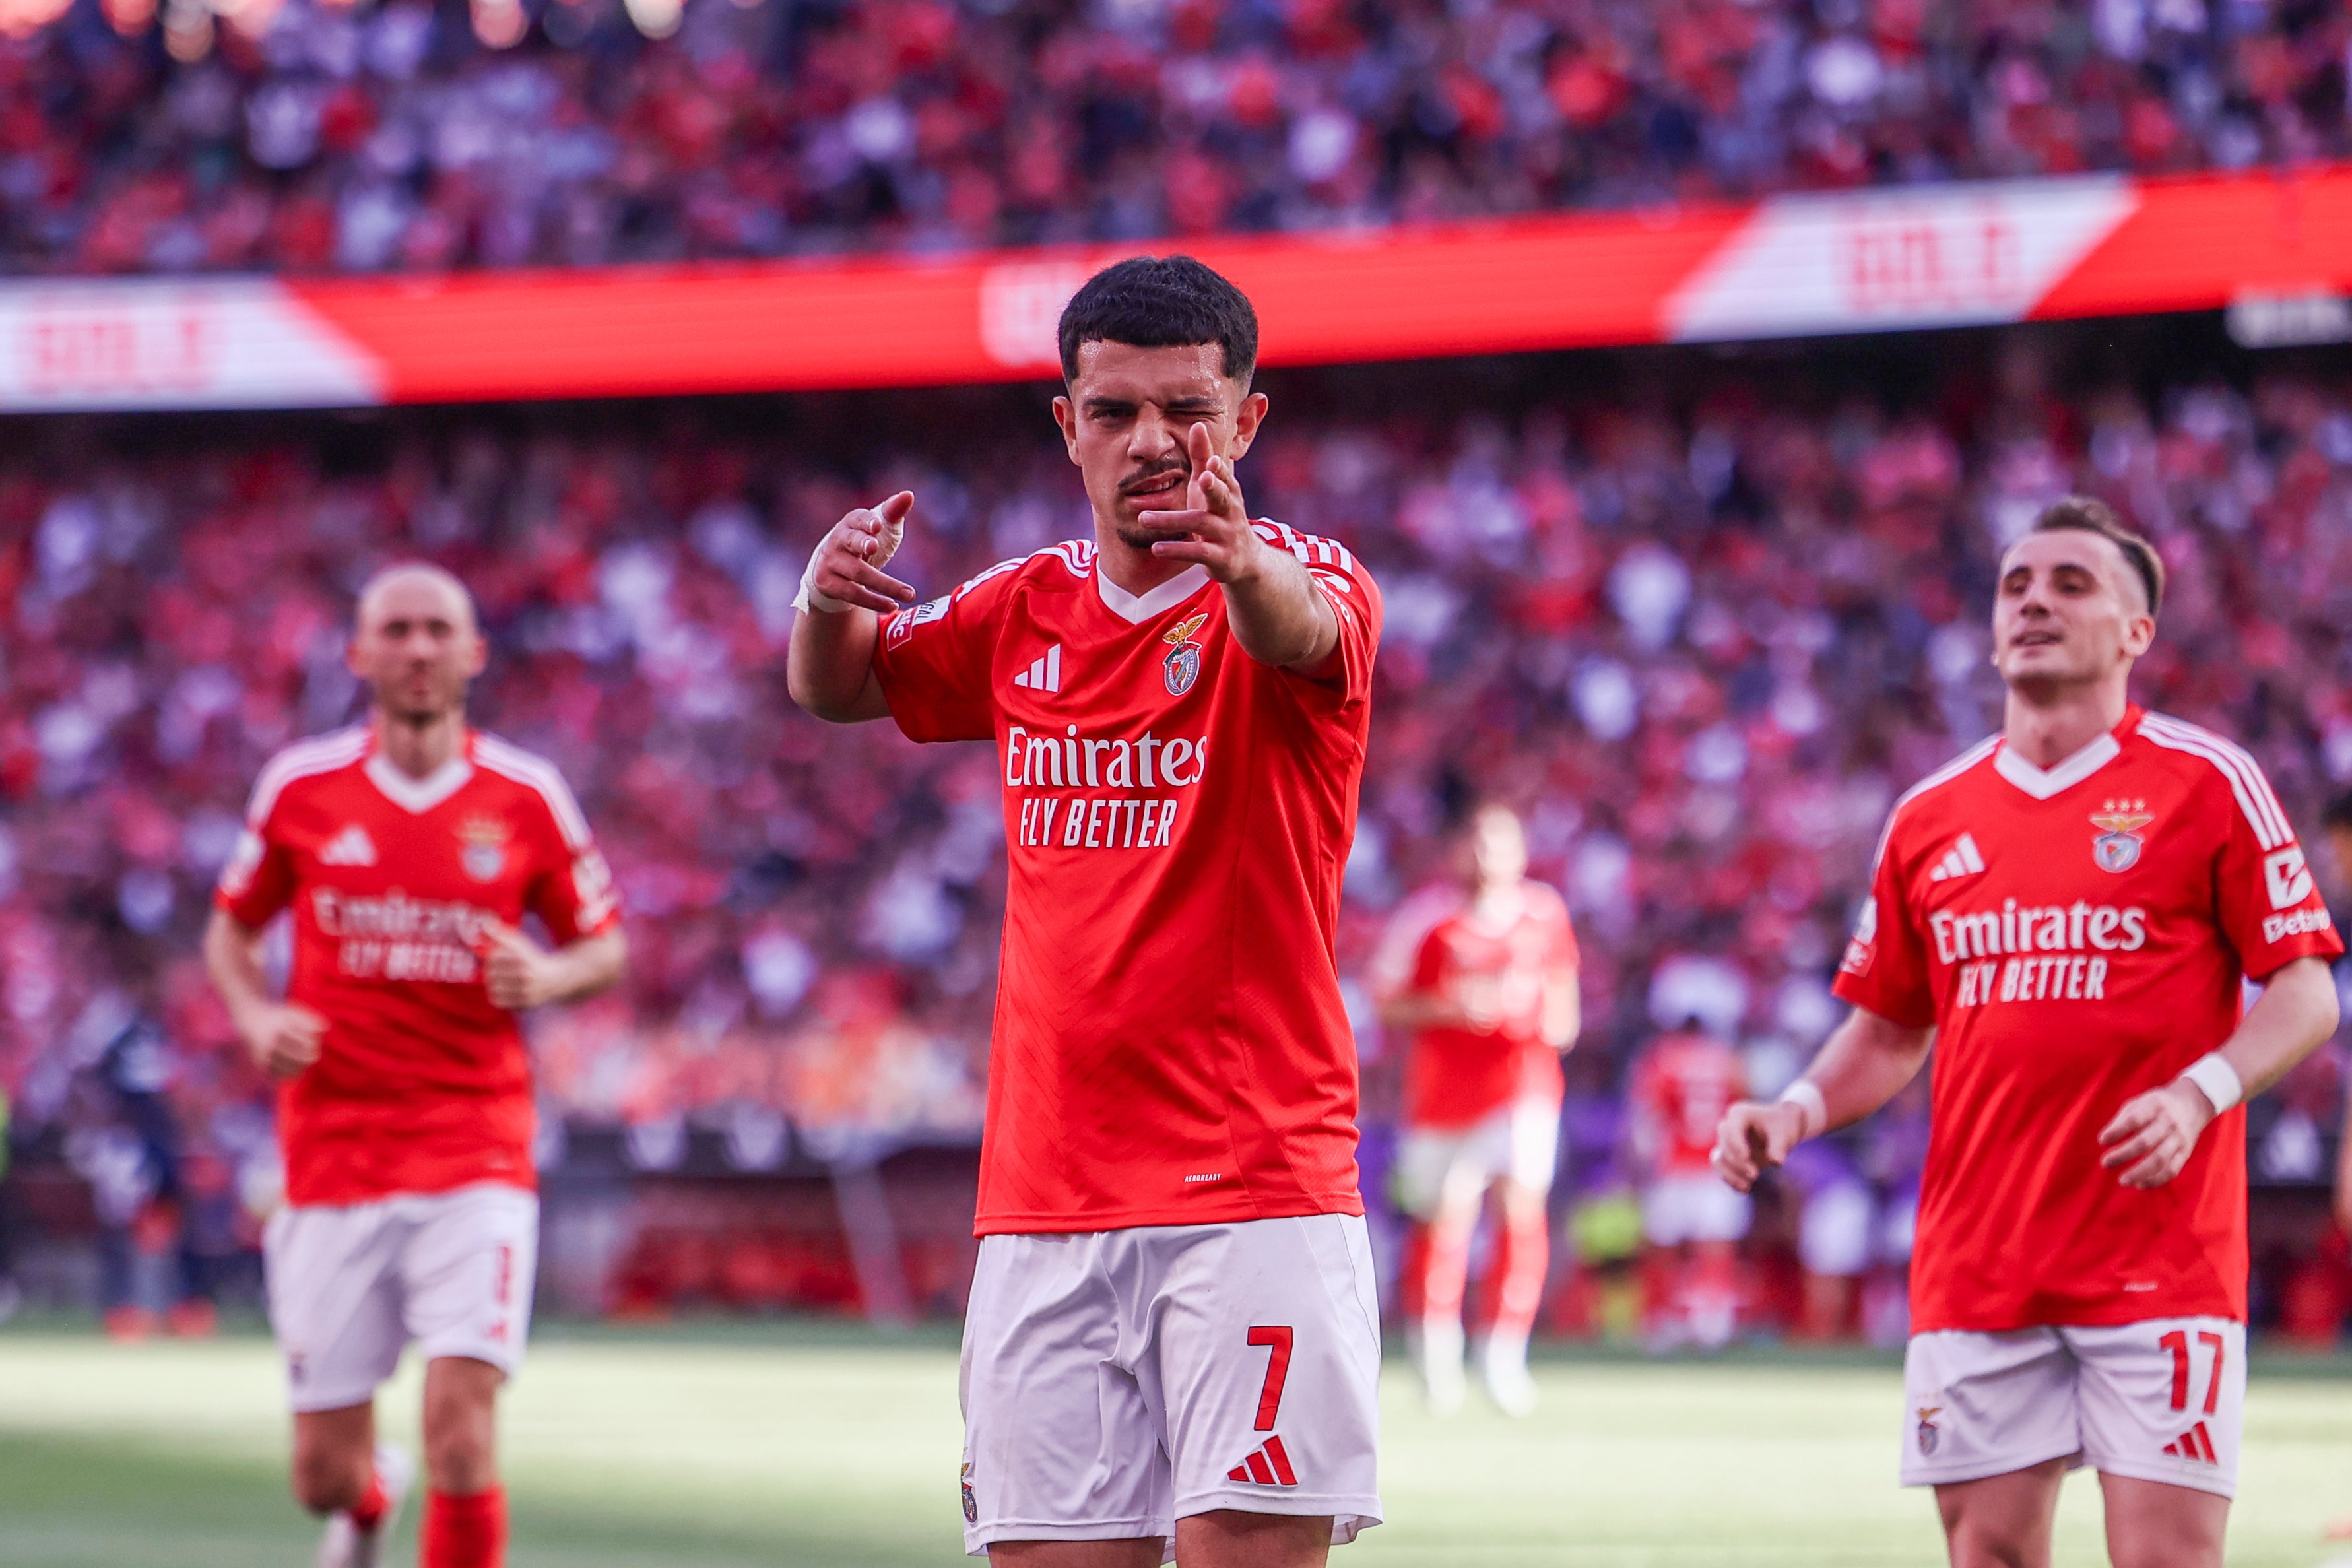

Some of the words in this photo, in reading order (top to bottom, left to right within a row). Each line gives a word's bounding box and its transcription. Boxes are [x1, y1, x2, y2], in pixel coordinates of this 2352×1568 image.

[1006, 723, 1208, 787] Emirates
[1020, 798, 1059, 847] FLY
[1063, 799, 1178, 848] BETTER
[1928, 898, 2146, 965] Emirates
[1955, 961, 1998, 1008] FLY
[1999, 955, 2108, 1003] BETTER
[1184, 1173, 1221, 1183] AEROREADY
[1247, 1326, 1293, 1431] 7
[2159, 1330, 2225, 1417] 17
